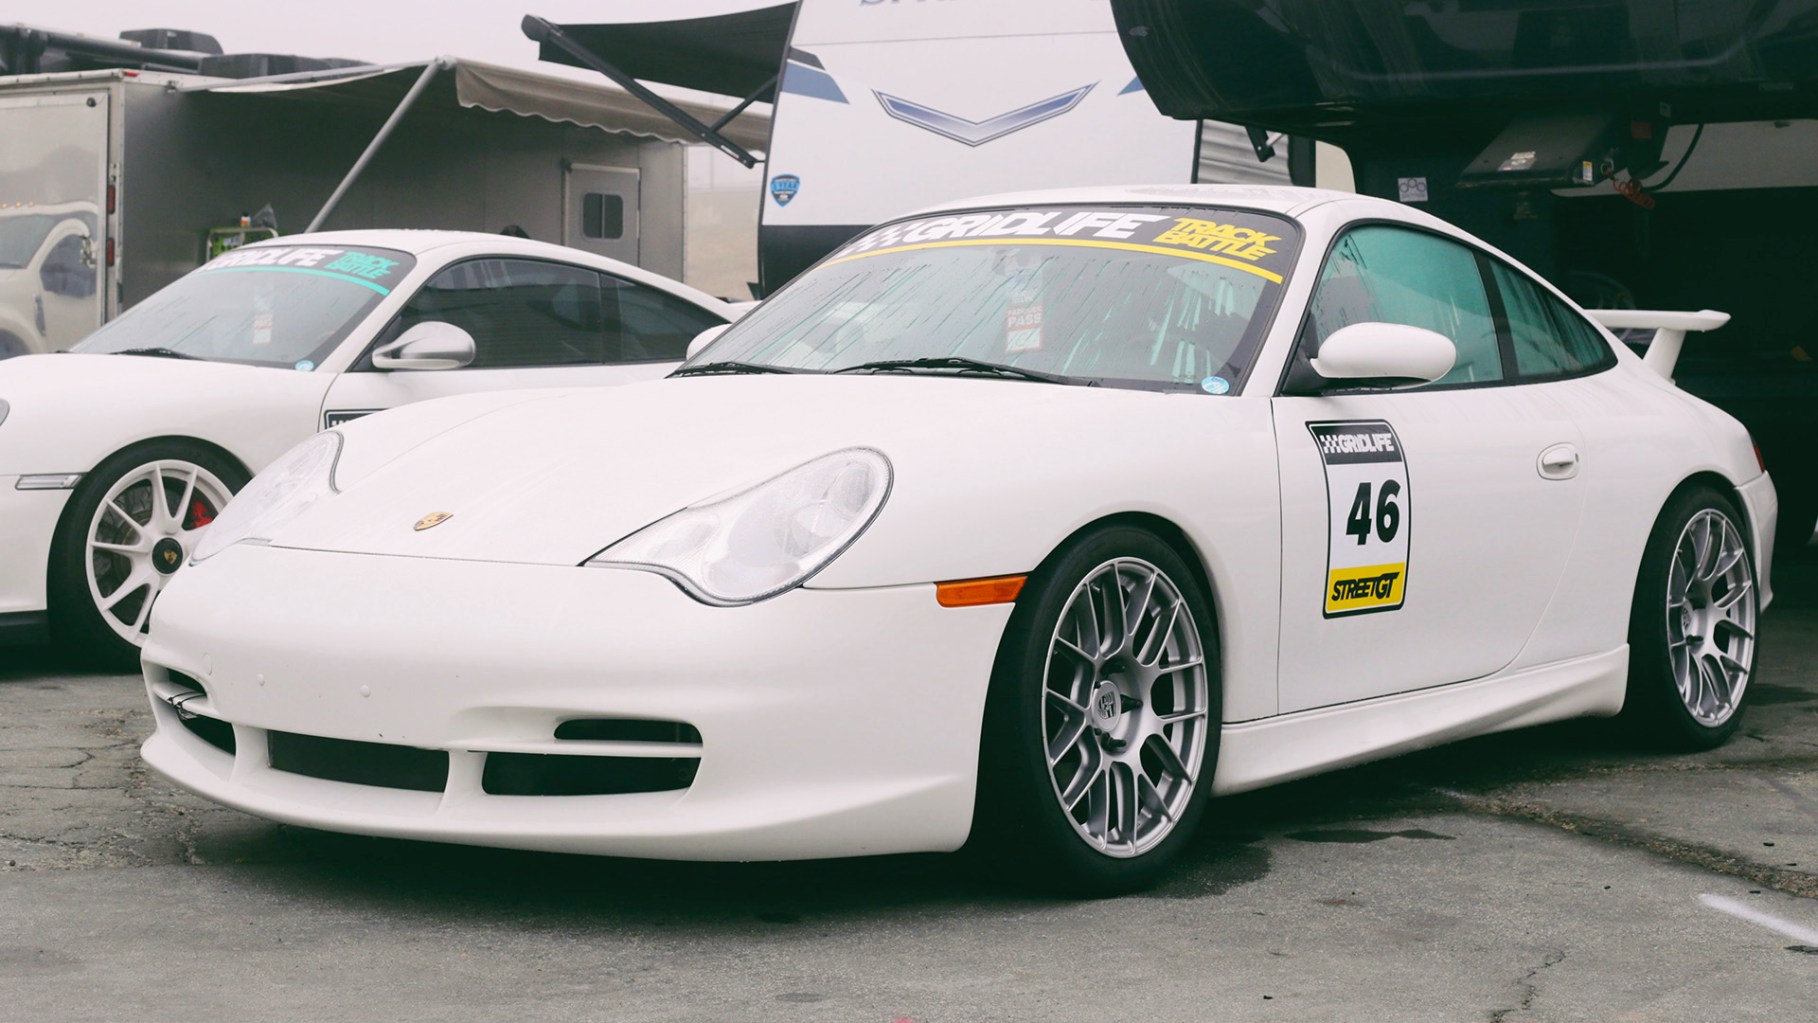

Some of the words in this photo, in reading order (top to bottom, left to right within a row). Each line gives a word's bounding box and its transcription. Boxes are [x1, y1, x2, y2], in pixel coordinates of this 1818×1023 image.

[903, 211, 1171, 244] GRIDLIFE
[1170, 217, 1282, 247] TRACK
[1152, 230, 1277, 261] BATTLE
[1007, 313, 1042, 327] PASS
[1338, 433, 1395, 453] GRIDLIFE
[1345, 479, 1402, 546] 46
